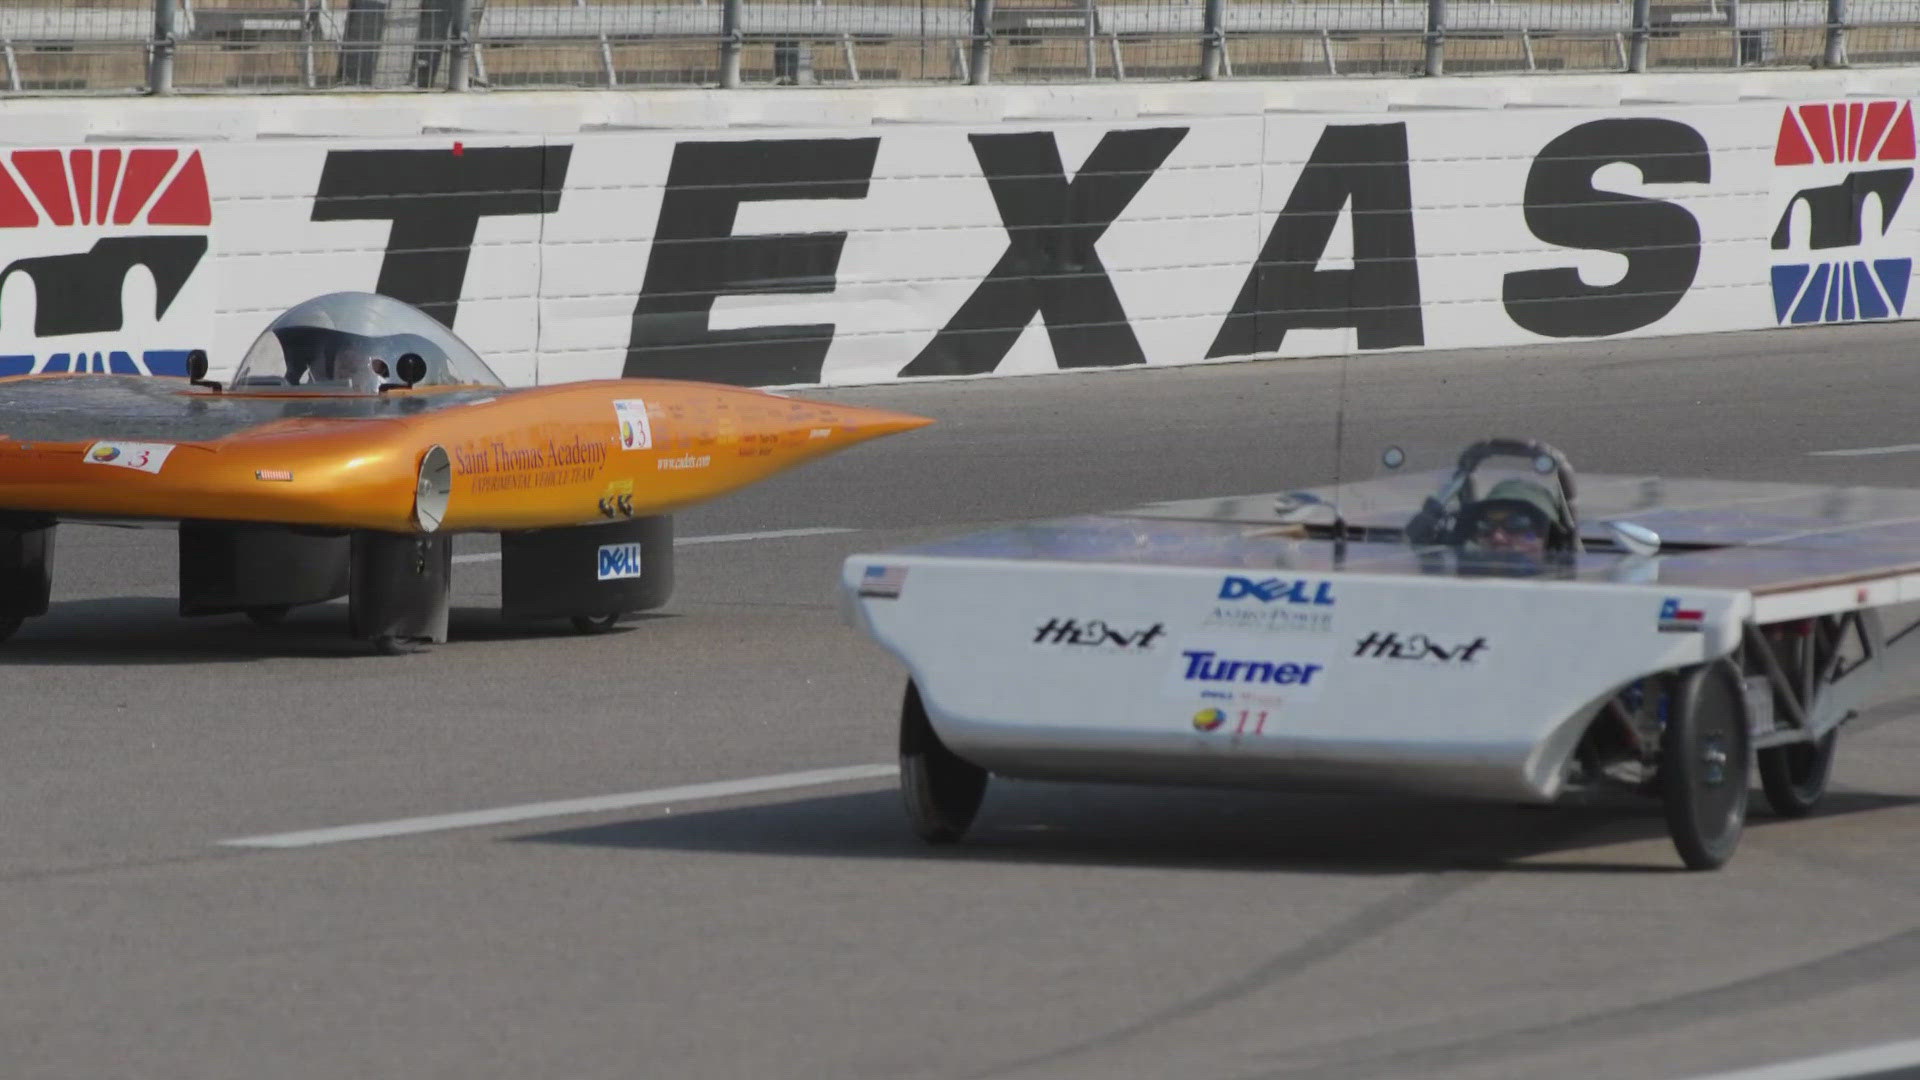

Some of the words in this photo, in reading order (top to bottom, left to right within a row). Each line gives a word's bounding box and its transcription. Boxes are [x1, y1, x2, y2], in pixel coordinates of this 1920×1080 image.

[311, 118, 1711, 386] TEXAS
[637, 420, 646, 448] 3
[455, 446, 489, 476] Saint
[491, 441, 545, 473] Thomas
[547, 434, 608, 470] Academy
[571, 467, 596, 485] TEAM
[599, 546, 639, 576] DELL
[1218, 576, 1336, 605] DELL
[1182, 650, 1323, 685] Turner
[1235, 710, 1269, 736] 11
